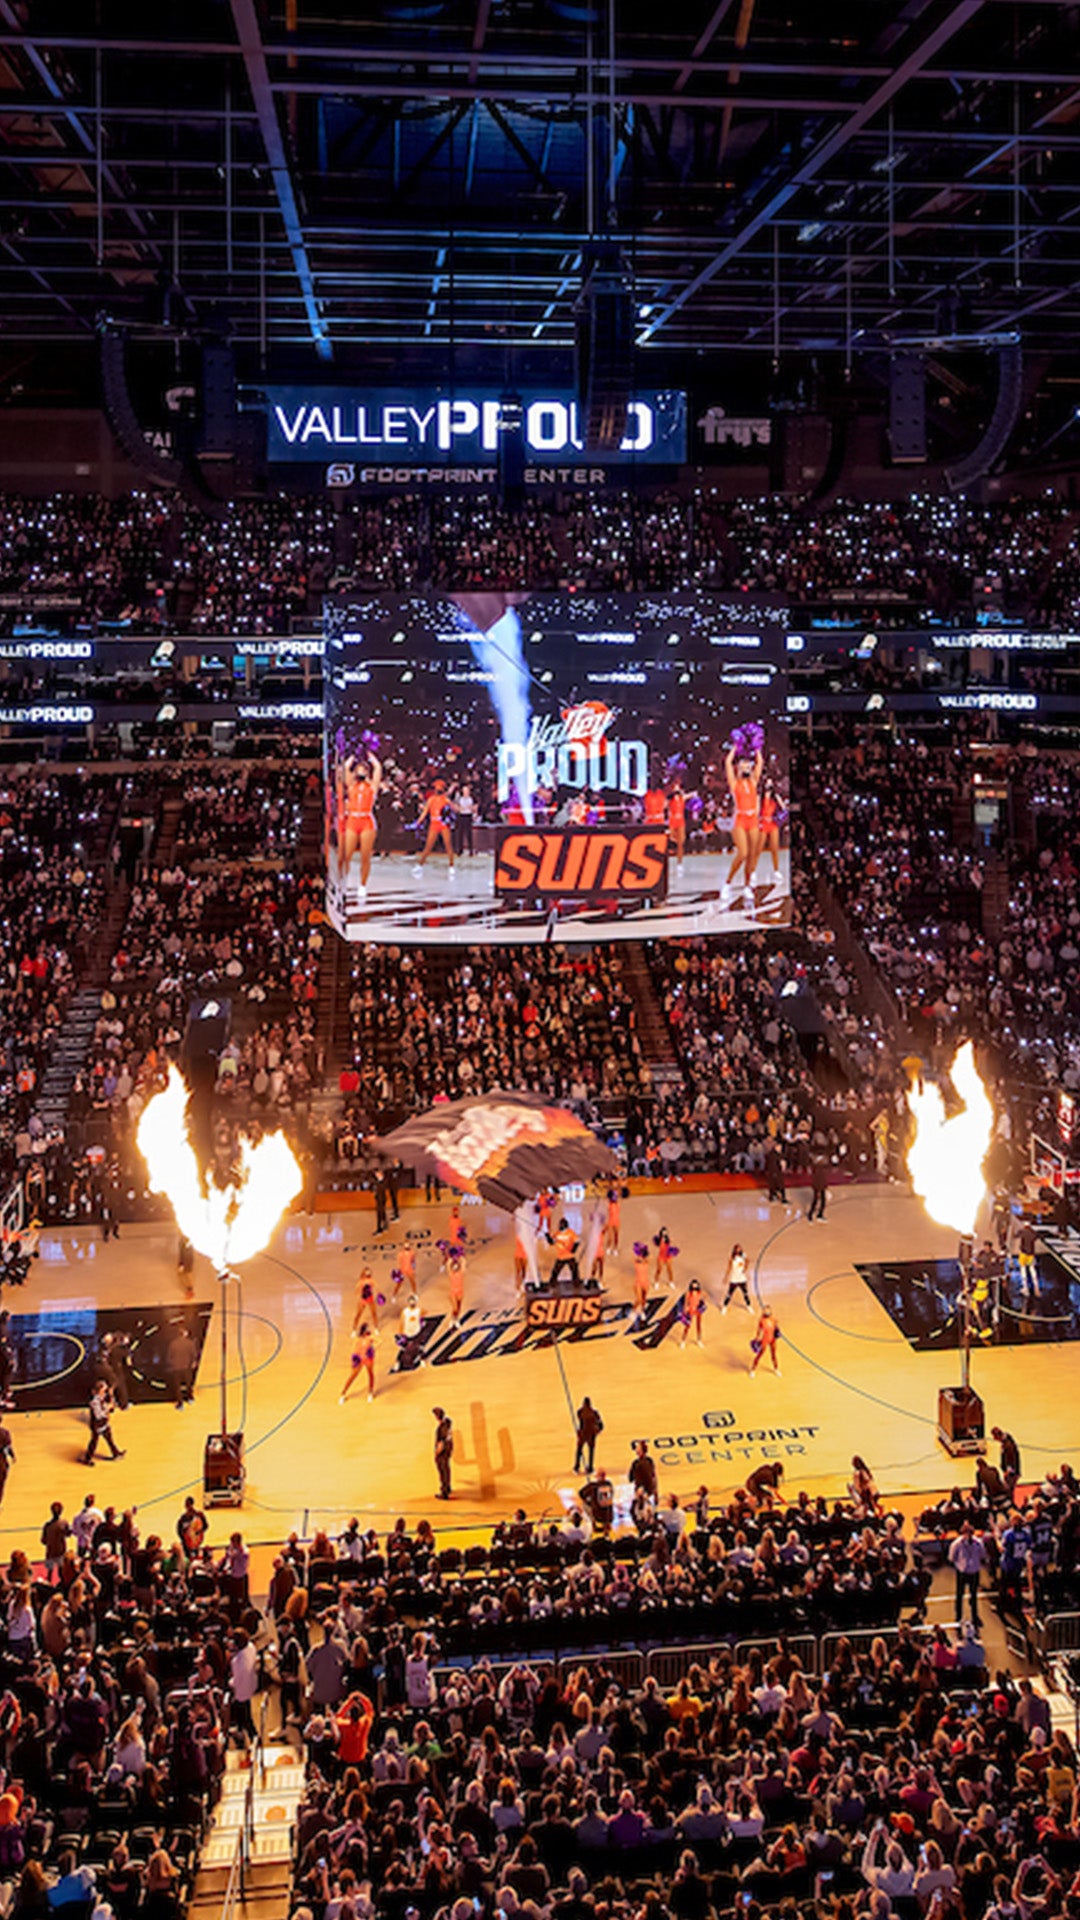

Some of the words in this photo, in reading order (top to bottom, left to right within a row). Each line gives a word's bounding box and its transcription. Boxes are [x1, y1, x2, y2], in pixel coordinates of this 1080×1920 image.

[360, 467, 499, 484] FOOTPRINT
[523, 468, 606, 483] ENTER
[236, 642, 325, 656] VALLEYPROU
[238, 703, 325, 719] VALLEYPROU
[497, 740, 648, 803] PROUD
[659, 1443, 808, 1467] CENTER
